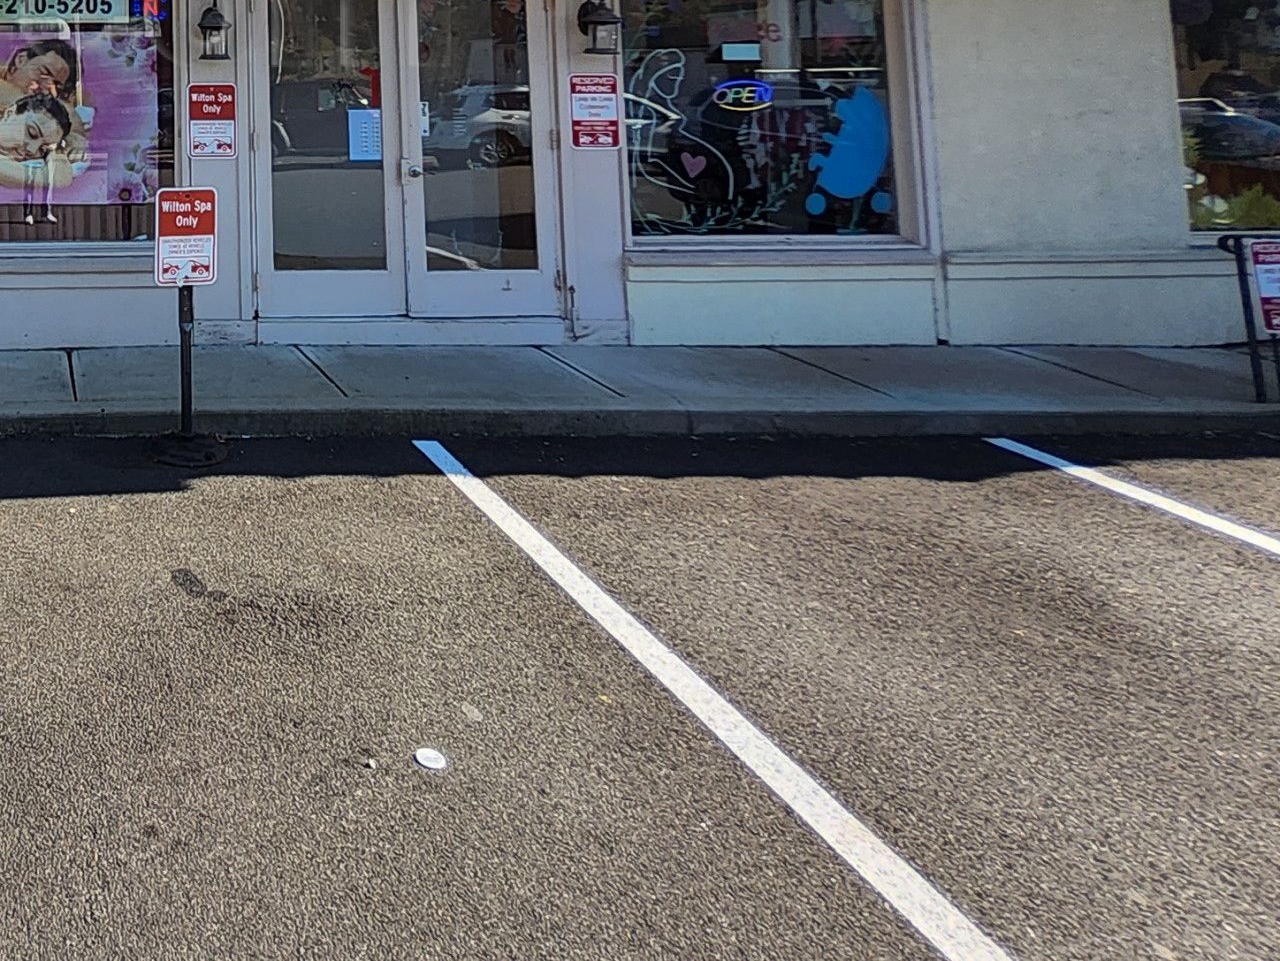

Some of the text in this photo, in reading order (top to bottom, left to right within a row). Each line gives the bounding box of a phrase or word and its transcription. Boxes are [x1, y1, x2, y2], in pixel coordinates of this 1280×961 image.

[572, 77, 615, 85] RESERVED
[575, 85, 612, 93] PARKING
[191, 92, 233, 103] Wilton Spa
[712, 86, 772, 104] OPEN
[202, 104, 222, 115] Only
[161, 200, 212, 213] Wilton Spa
[175, 215, 199, 228] Only
